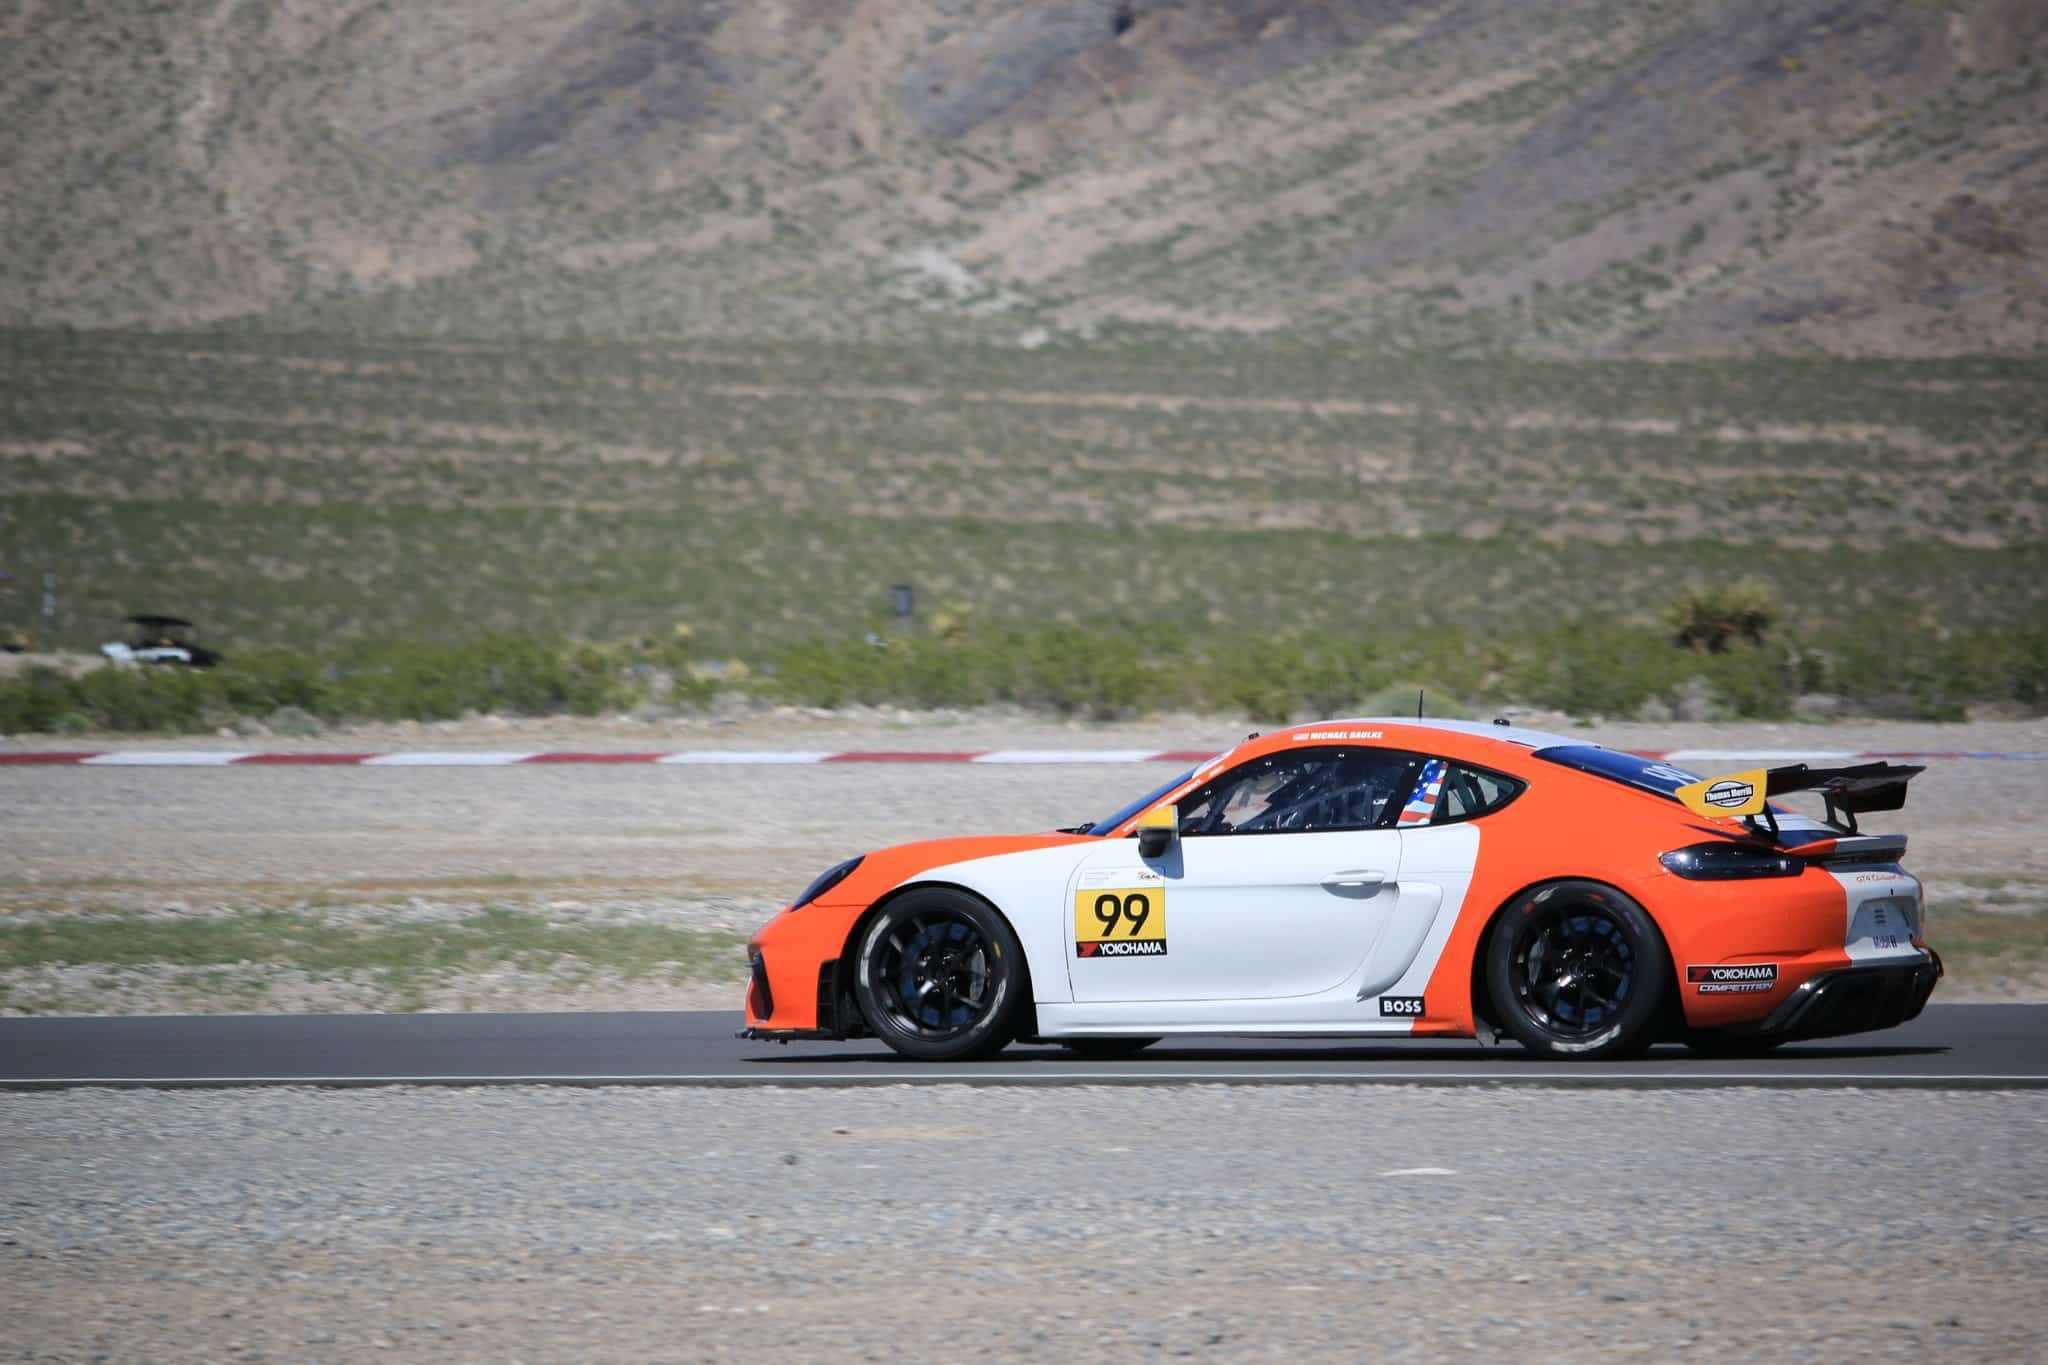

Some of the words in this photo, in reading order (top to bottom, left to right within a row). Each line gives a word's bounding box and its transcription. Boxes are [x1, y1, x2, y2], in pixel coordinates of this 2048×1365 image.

[1310, 731, 1347, 741] MICHAEL
[1706, 789, 1731, 802] Thomas
[1095, 893, 1150, 937] 99
[1099, 941, 1163, 955] YOKOHAMA
[1711, 967, 1774, 980] YOKOHAMA
[1383, 1000, 1422, 1013] BOSS
